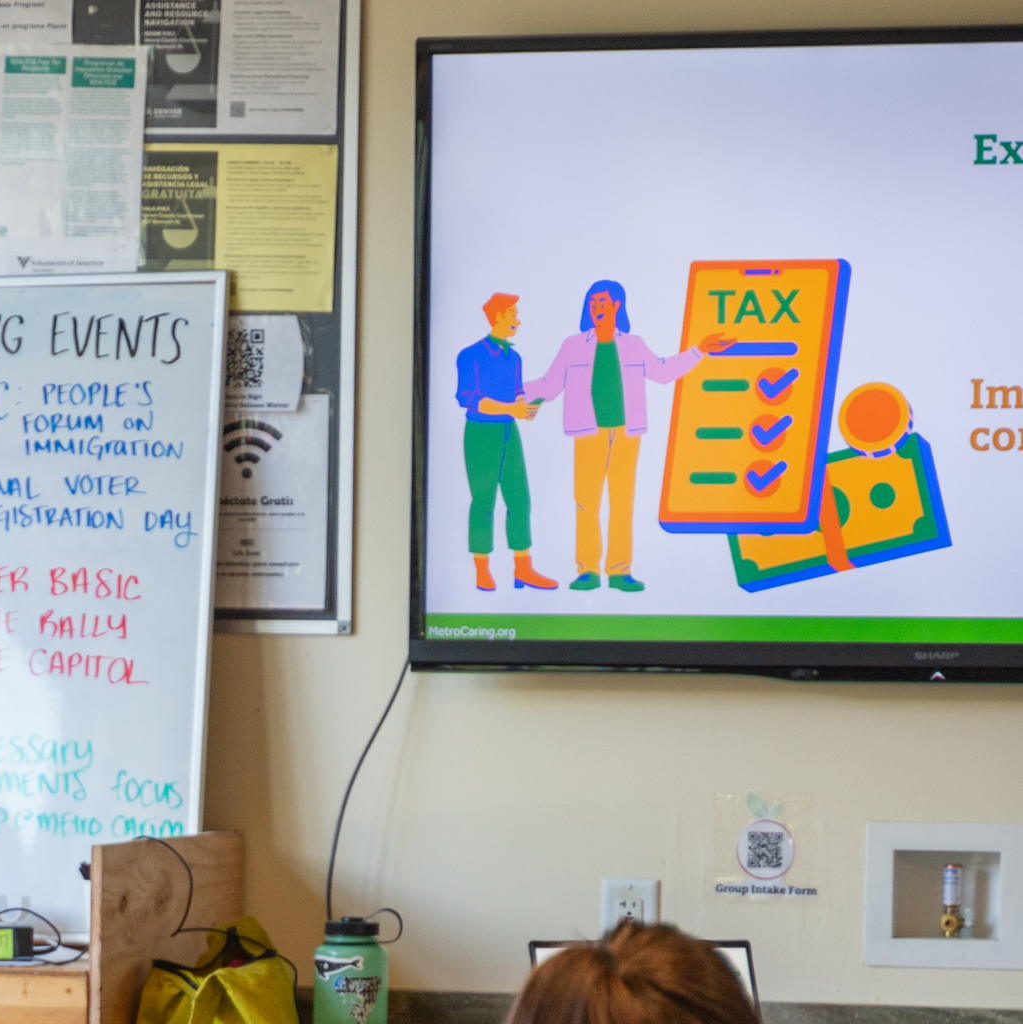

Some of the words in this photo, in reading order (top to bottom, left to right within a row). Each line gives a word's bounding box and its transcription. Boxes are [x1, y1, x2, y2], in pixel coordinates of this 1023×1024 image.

[973, 133, 1023, 165] Ex
[708, 289, 801, 324] TAX
[51, 311, 189, 364] EVENTS
[42, 380, 154, 407] PEOPLE'S
[971, 378, 1023, 409] Im
[23, 412, 104, 434] FORUM
[123, 410, 154, 432] ON
[64, 474, 147, 496] VOTER
[49, 567, 142, 601] BASIC
[40, 609, 127, 639] RALLY
[428, 626, 516, 641] MetroCaring.org
[28, 649, 150, 685] CAPITOL
[914, 651, 960, 660] SHARP
[715, 883, 749, 895] Group
[751, 885, 786, 895] Intake
[788, 886, 818, 895] Form
